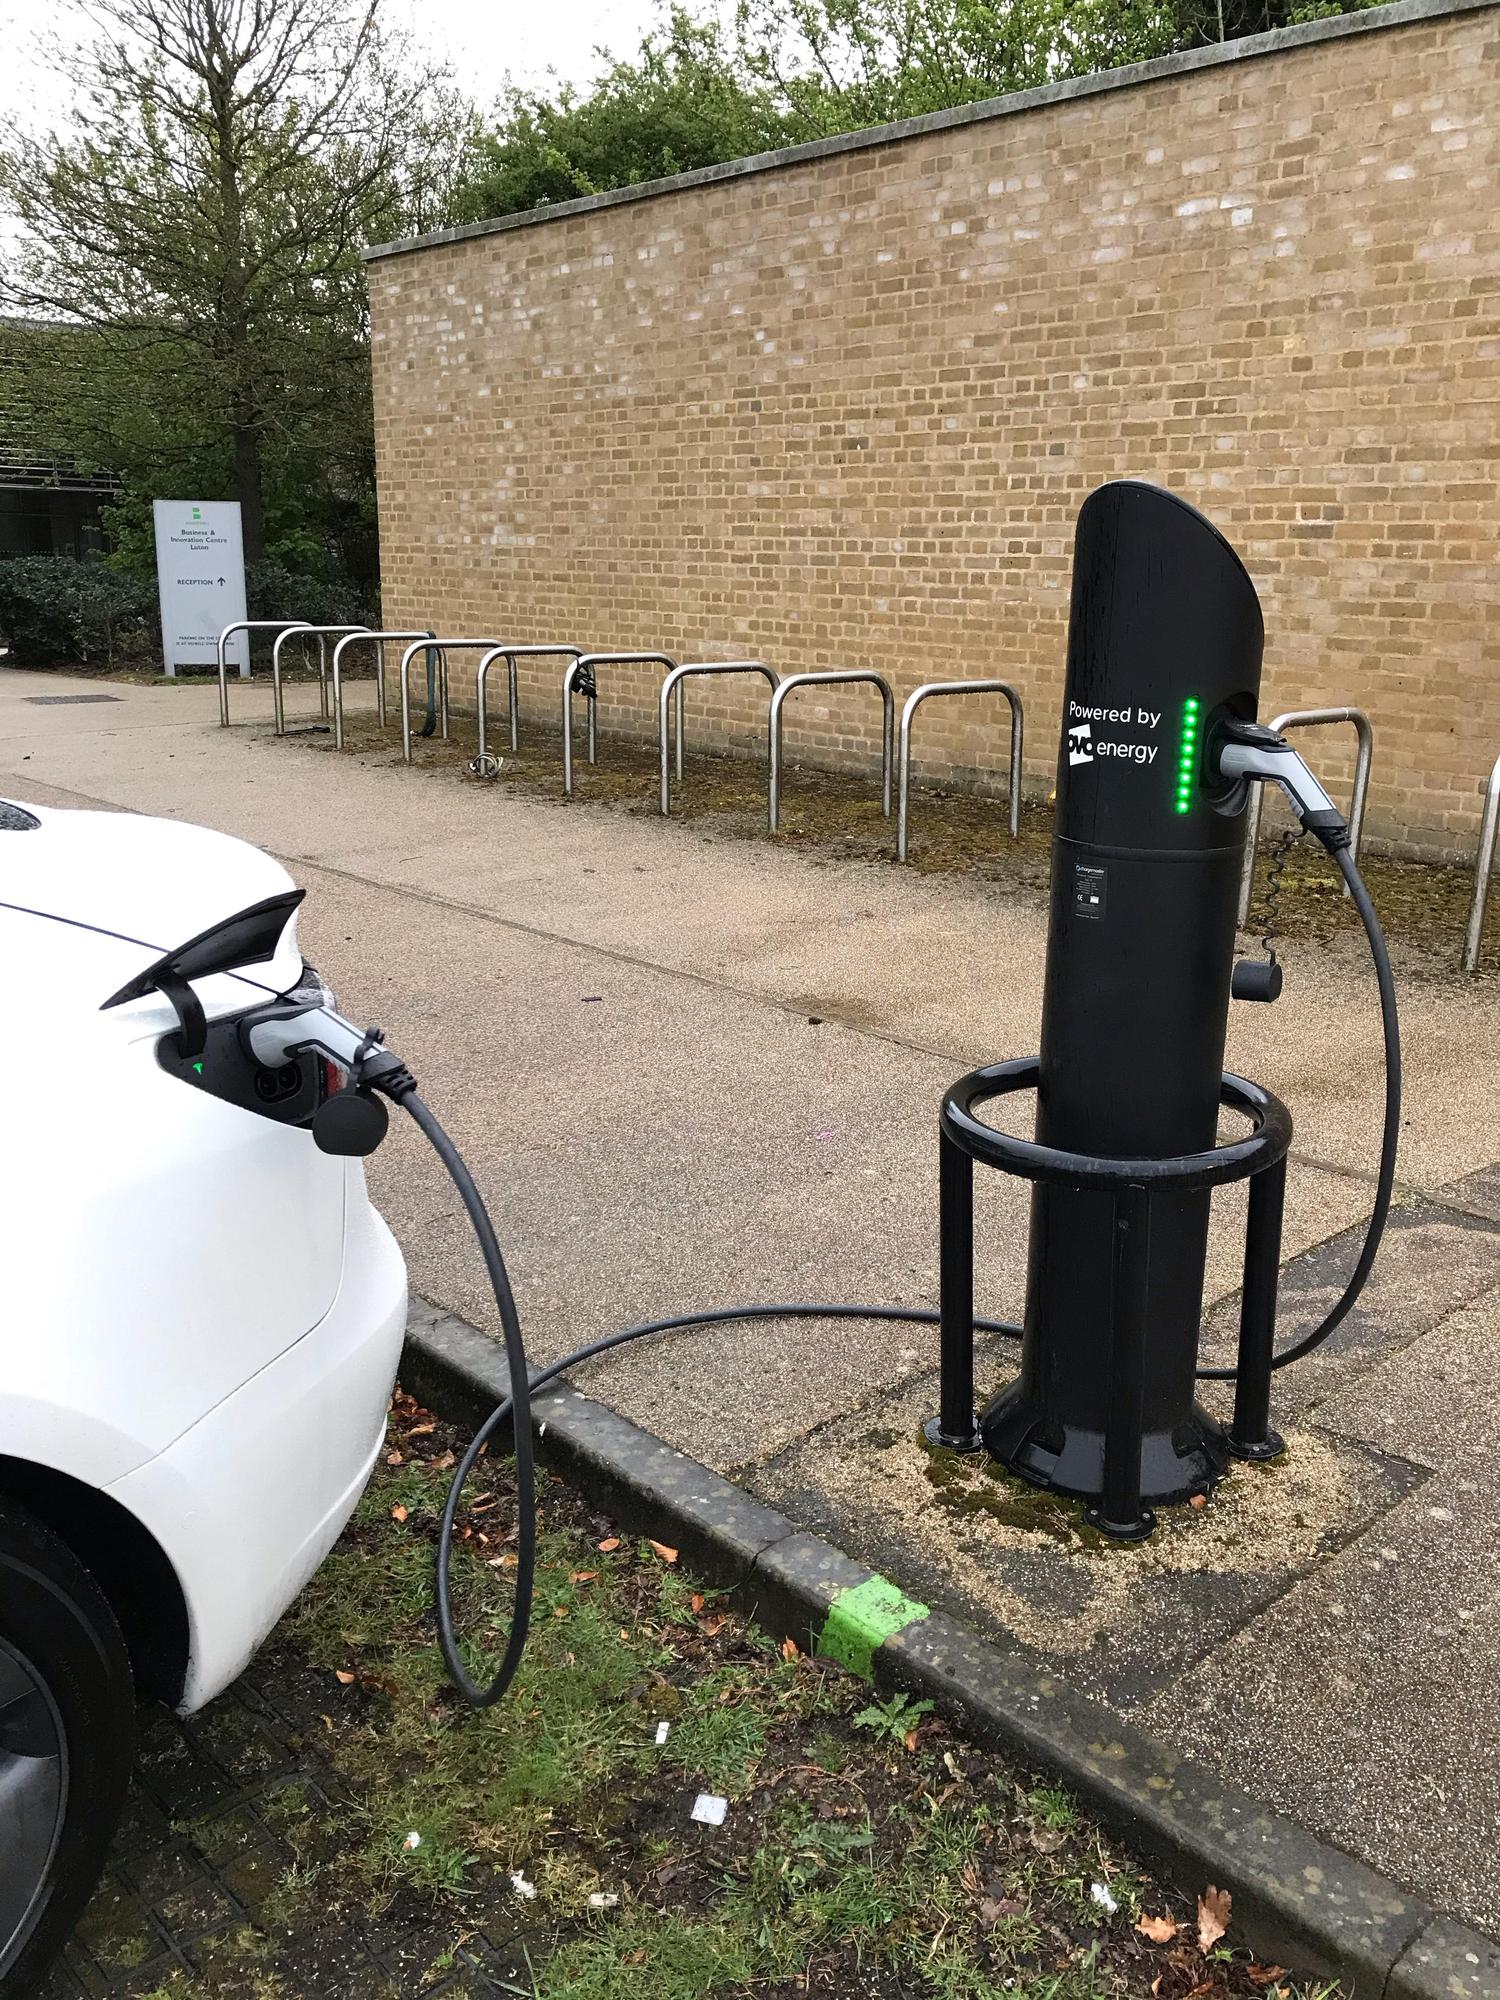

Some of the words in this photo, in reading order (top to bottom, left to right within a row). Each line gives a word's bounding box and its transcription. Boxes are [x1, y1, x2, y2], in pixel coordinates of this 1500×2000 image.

[1069, 700, 1132, 723] Powered
[1138, 707, 1161, 729] by
[1096, 741, 1158, 764] energy
